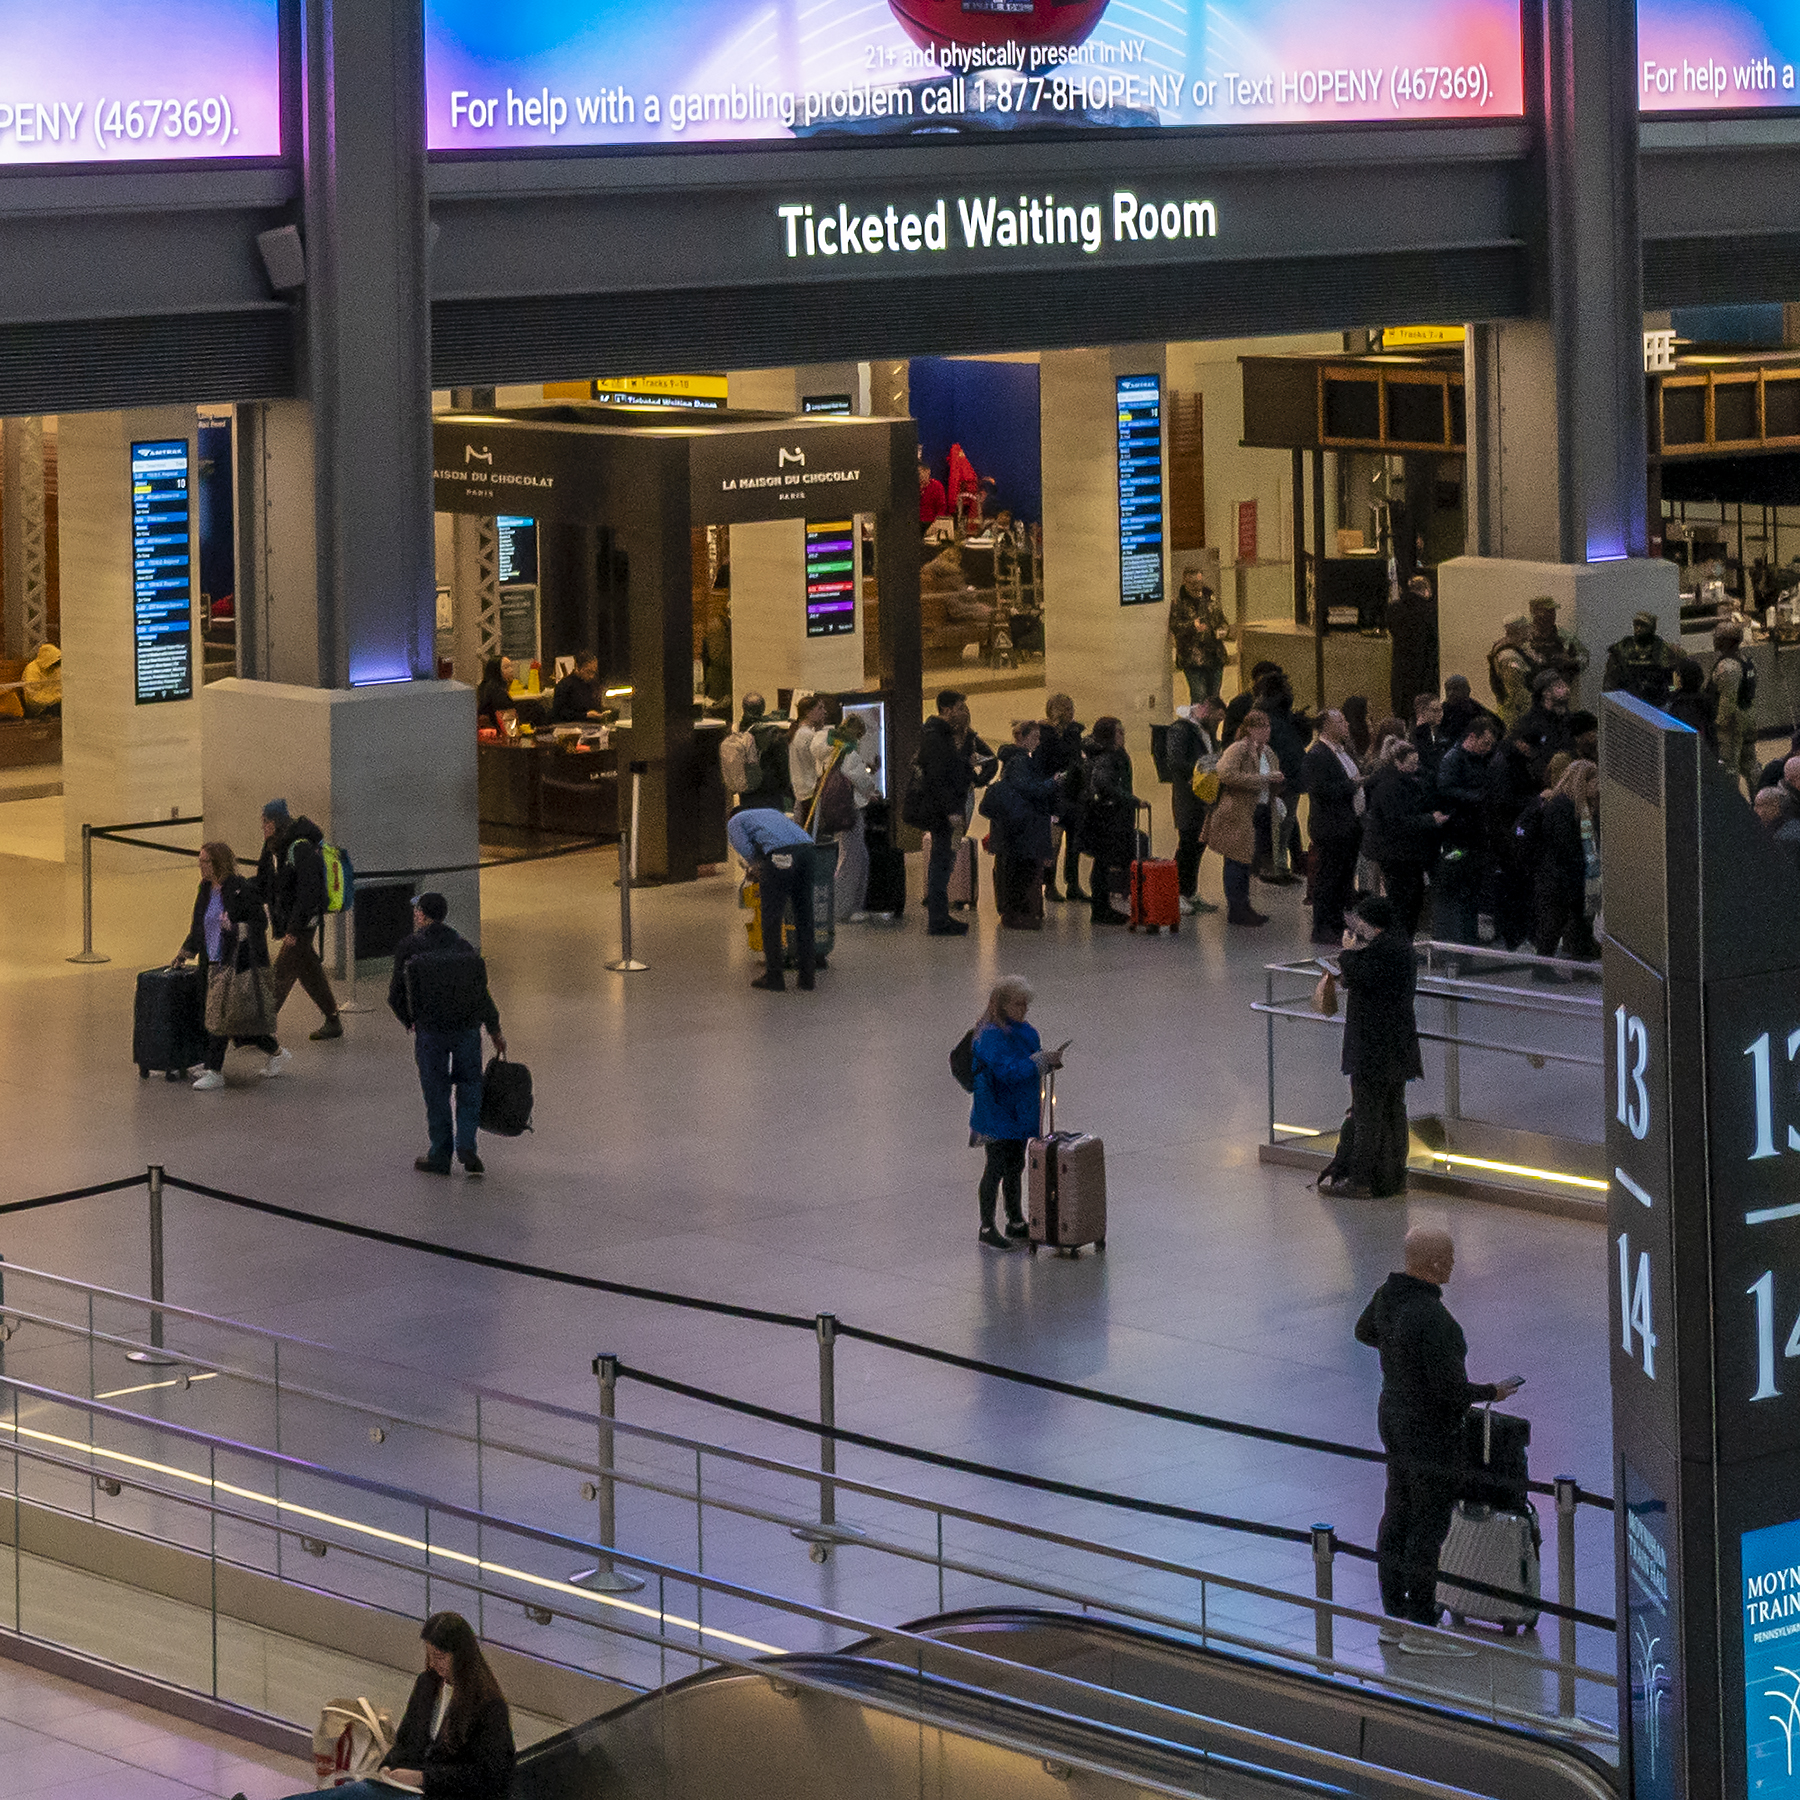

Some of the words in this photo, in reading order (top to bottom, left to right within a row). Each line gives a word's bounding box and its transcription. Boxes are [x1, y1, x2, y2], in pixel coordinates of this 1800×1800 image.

[864, 43, 897, 69] 21+
[902, 41, 937, 69] and
[941, 39, 1026, 77] physically
[1030, 40, 1095, 71] present
[1100, 42, 1116, 65] in
[1644, 61, 1677, 93] For
[1684, 58, 1727, 98] help
[1733, 57, 1776, 90] with
[1782, 64, 1795, 89] a
[92, 95, 240, 150] (467369).
[451, 91, 499, 129] For
[506, 87, 568, 134] help
[576, 86, 636, 125] with
[644, 93, 663, 123] a
[669, 83, 796, 132] gambling
[804, 80, 914, 126] problem
[922, 77, 966, 115] call
[975, 73, 1186, 112] 1-877-8HOPE-NY
[1192, 77, 1218, 107] or
[1224, 71, 1274, 106] Text
[1282, 68, 1384, 103] HOPENY
[1390, 63, 1494, 110] (467369).
[778, 199, 946, 258] Ticketed
[959, 194, 1102, 252] Waiting
[1114, 190, 1218, 242] Room
[432, 469, 468, 480] AISON
[471, 471, 488, 482] DU
[491, 473, 554, 488] CHOCOLAT
[722, 479, 737, 490] LA
[739, 476, 782, 489] MAISON
[784, 475, 800, 485] DU
[802, 470, 860, 484] CHOCOLAT
[1614, 1003, 1650, 1141] 13
[1616, 1233, 1657, 1381] 14
